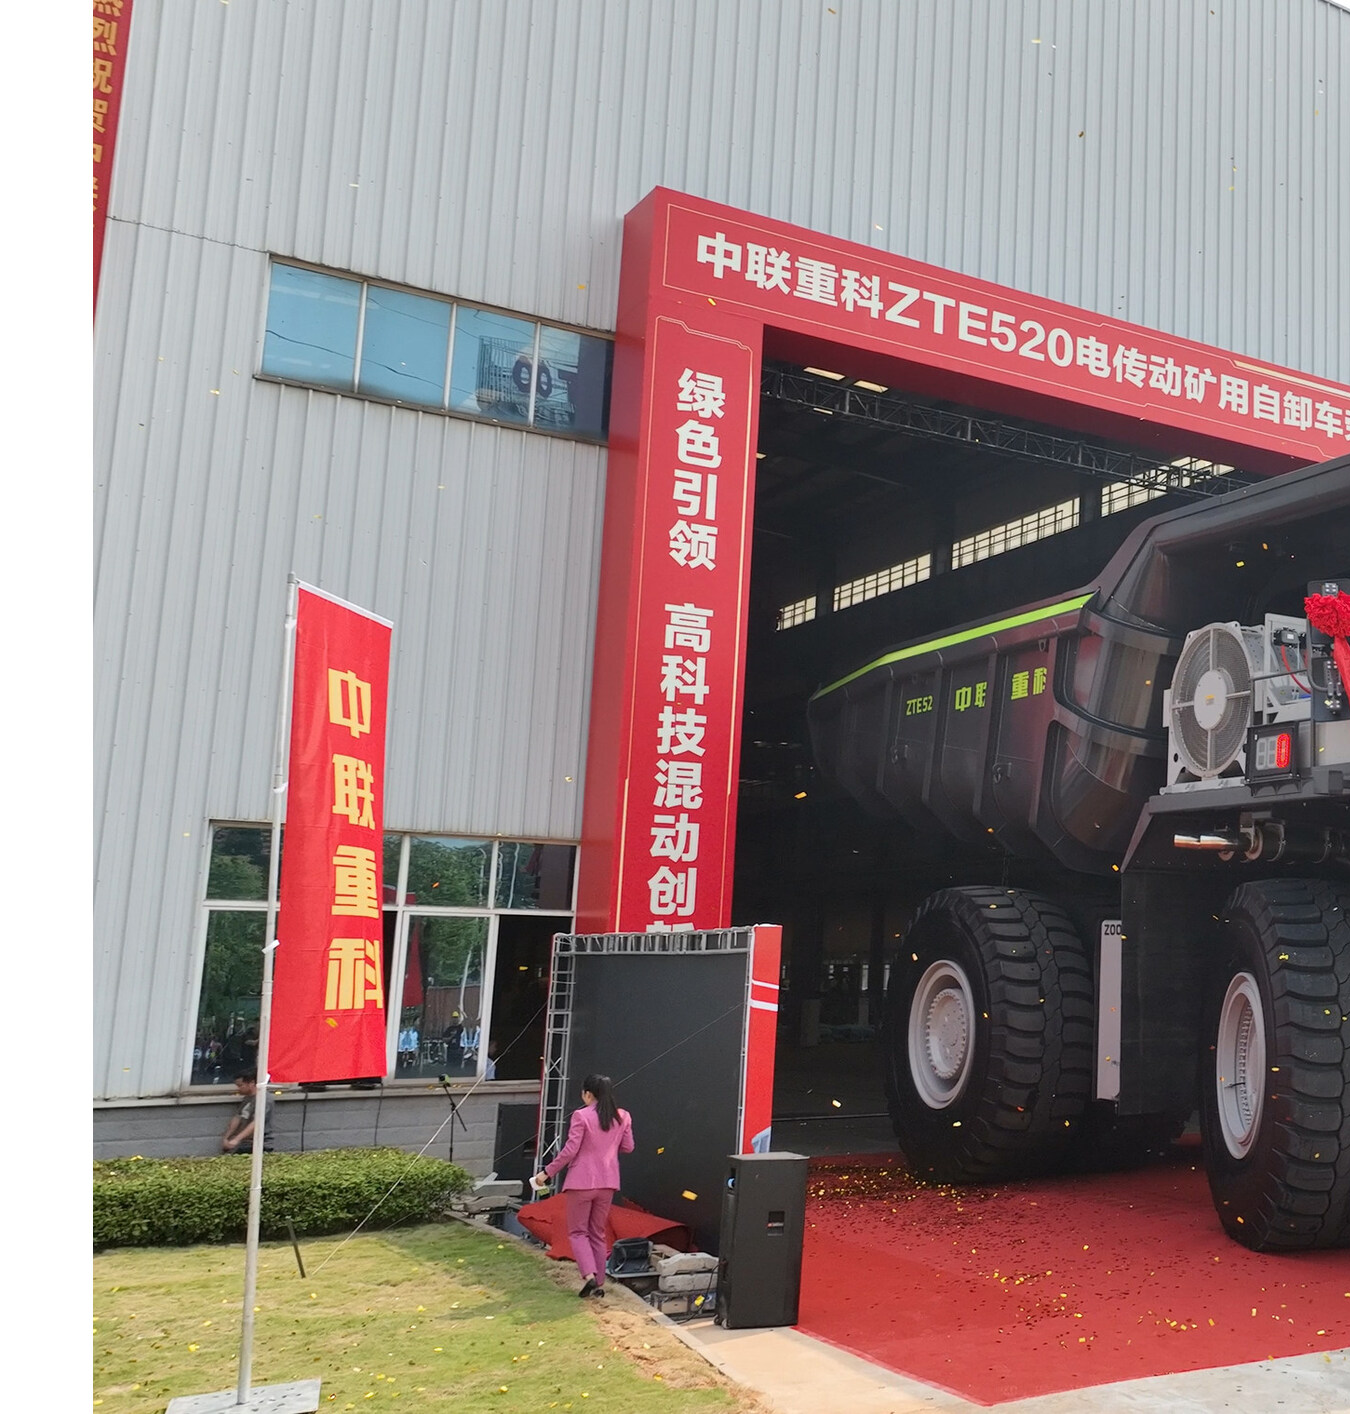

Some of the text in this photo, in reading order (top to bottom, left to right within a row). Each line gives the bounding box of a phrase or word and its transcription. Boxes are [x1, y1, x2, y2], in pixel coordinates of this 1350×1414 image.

[646, 368, 725, 932] 绿色引领 高科技混动创
